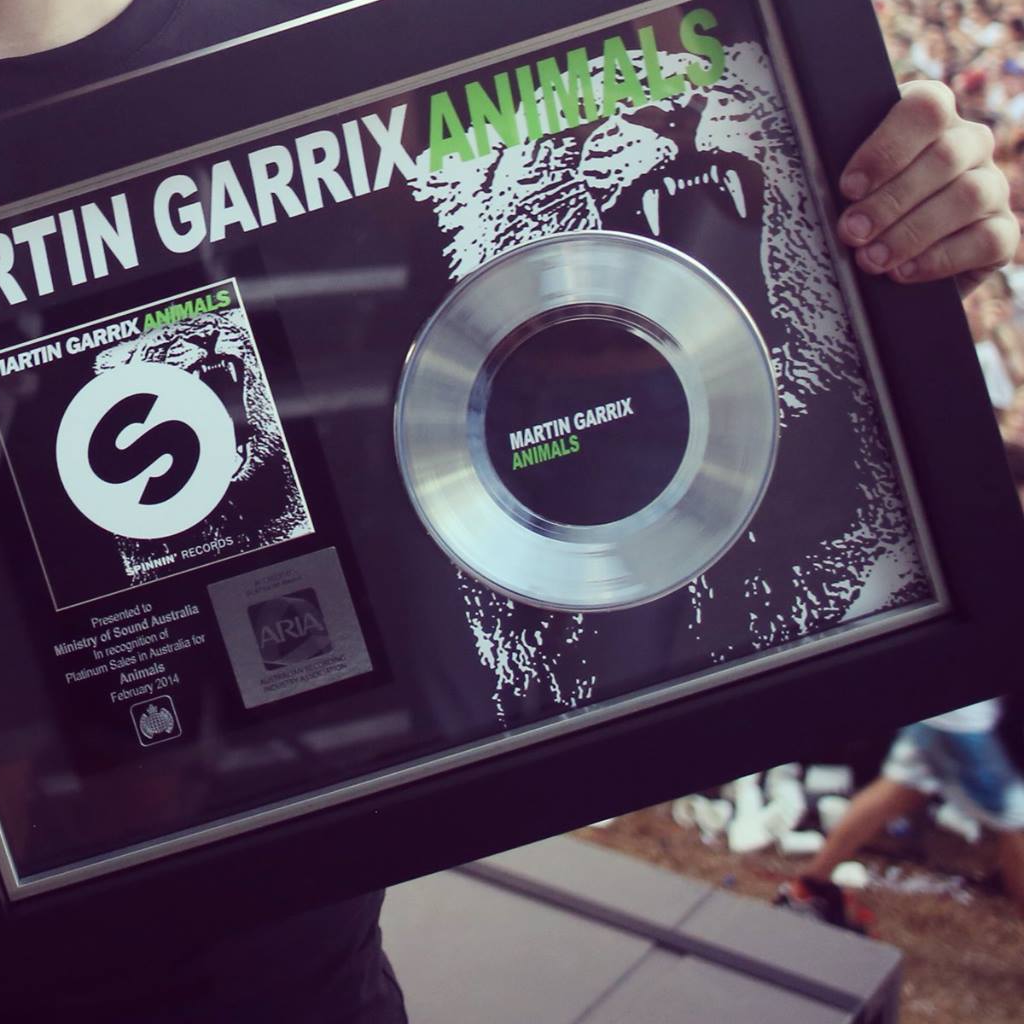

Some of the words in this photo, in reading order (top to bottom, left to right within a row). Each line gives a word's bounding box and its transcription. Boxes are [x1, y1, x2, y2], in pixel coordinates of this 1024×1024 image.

[153, 104, 418, 254] GARRIX
[429, 8, 726, 172] ANIMALS
[65, 317, 141, 355] GARRIX
[142, 290, 231, 329] ANIMALS
[509, 416, 571, 450] MARTIN
[574, 397, 634, 430] GARRIX
[512, 434, 580, 470] ANIMALS
[181, 536, 234, 559] RECORDS
[53, 636, 98, 656] Ministry
[100, 631, 112, 643] of
[113, 619, 149, 638] Sound
[151, 604, 200, 628] Australia
[91, 604, 140, 628] Presented
[142, 603, 152, 614] to
[260, 612, 324, 648] ARIA
[65, 664, 108, 684] Platinum
[109, 655, 137, 670] Sales
[138, 651, 148, 662] in
[149, 639, 191, 658] Australia
[192, 634, 205, 646] for
[105, 635, 158, 656] recognition
[159, 628, 169, 640] of
[110, 682, 153, 703] February
[157, 673, 180, 690] 2014
[119, 662, 166, 685] Animals
